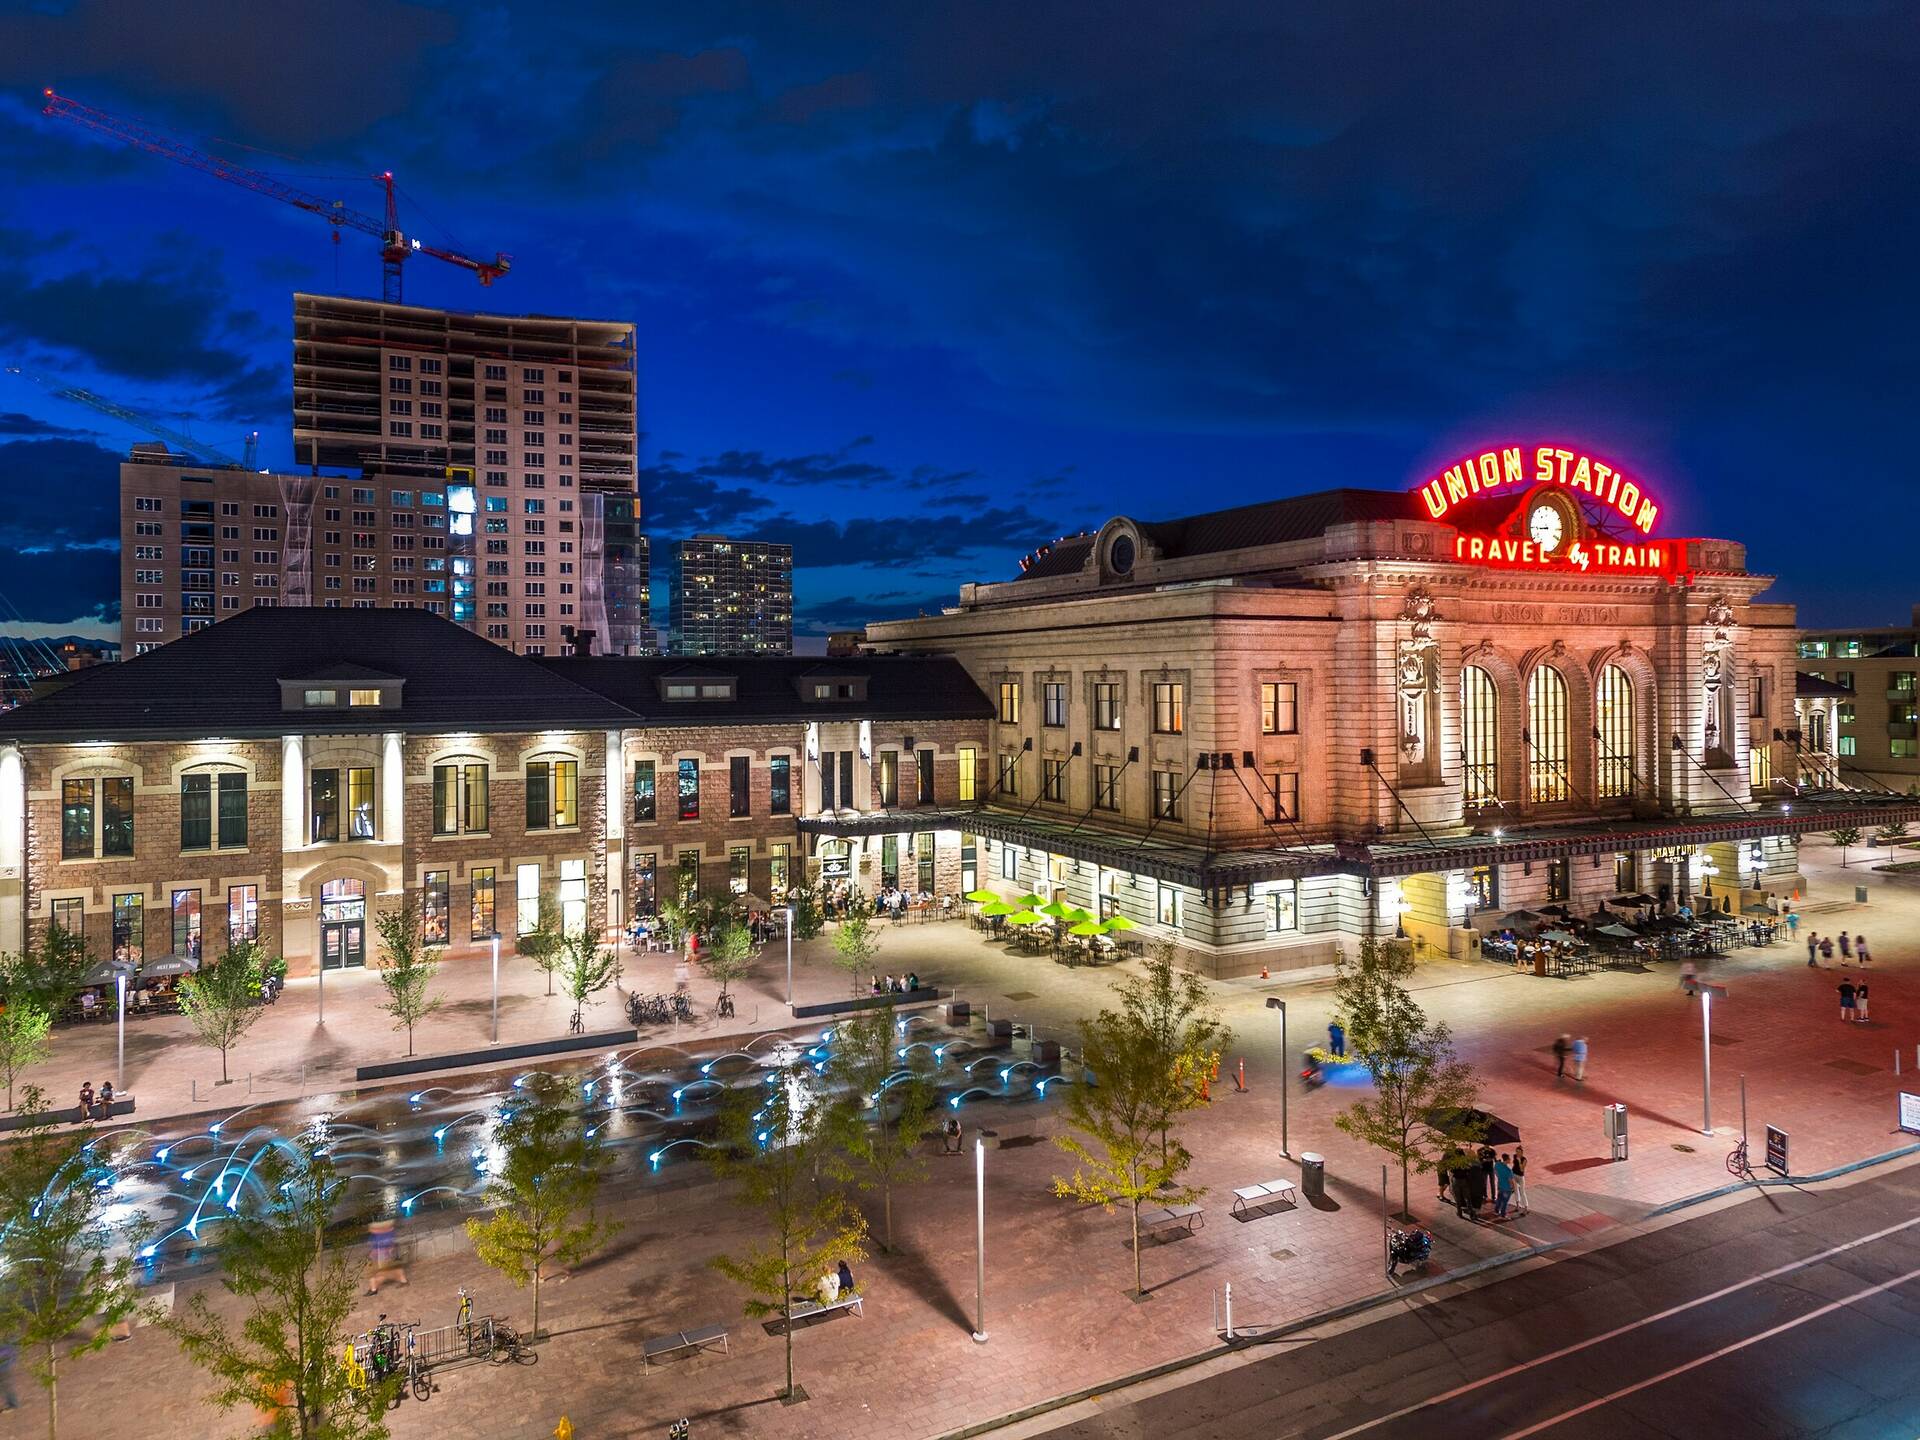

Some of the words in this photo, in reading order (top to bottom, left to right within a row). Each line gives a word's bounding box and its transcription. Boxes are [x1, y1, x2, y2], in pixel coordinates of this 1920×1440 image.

[1422, 447, 1522, 519] UNION
[1536, 447, 1658, 534] STATION
[1457, 536, 1550, 563] TRAVEL
[1568, 542, 1589, 571] by
[1595, 544, 1660, 568] TRAIN
[1491, 604, 1544, 622] UNION
[1558, 606, 1620, 623] STATION
